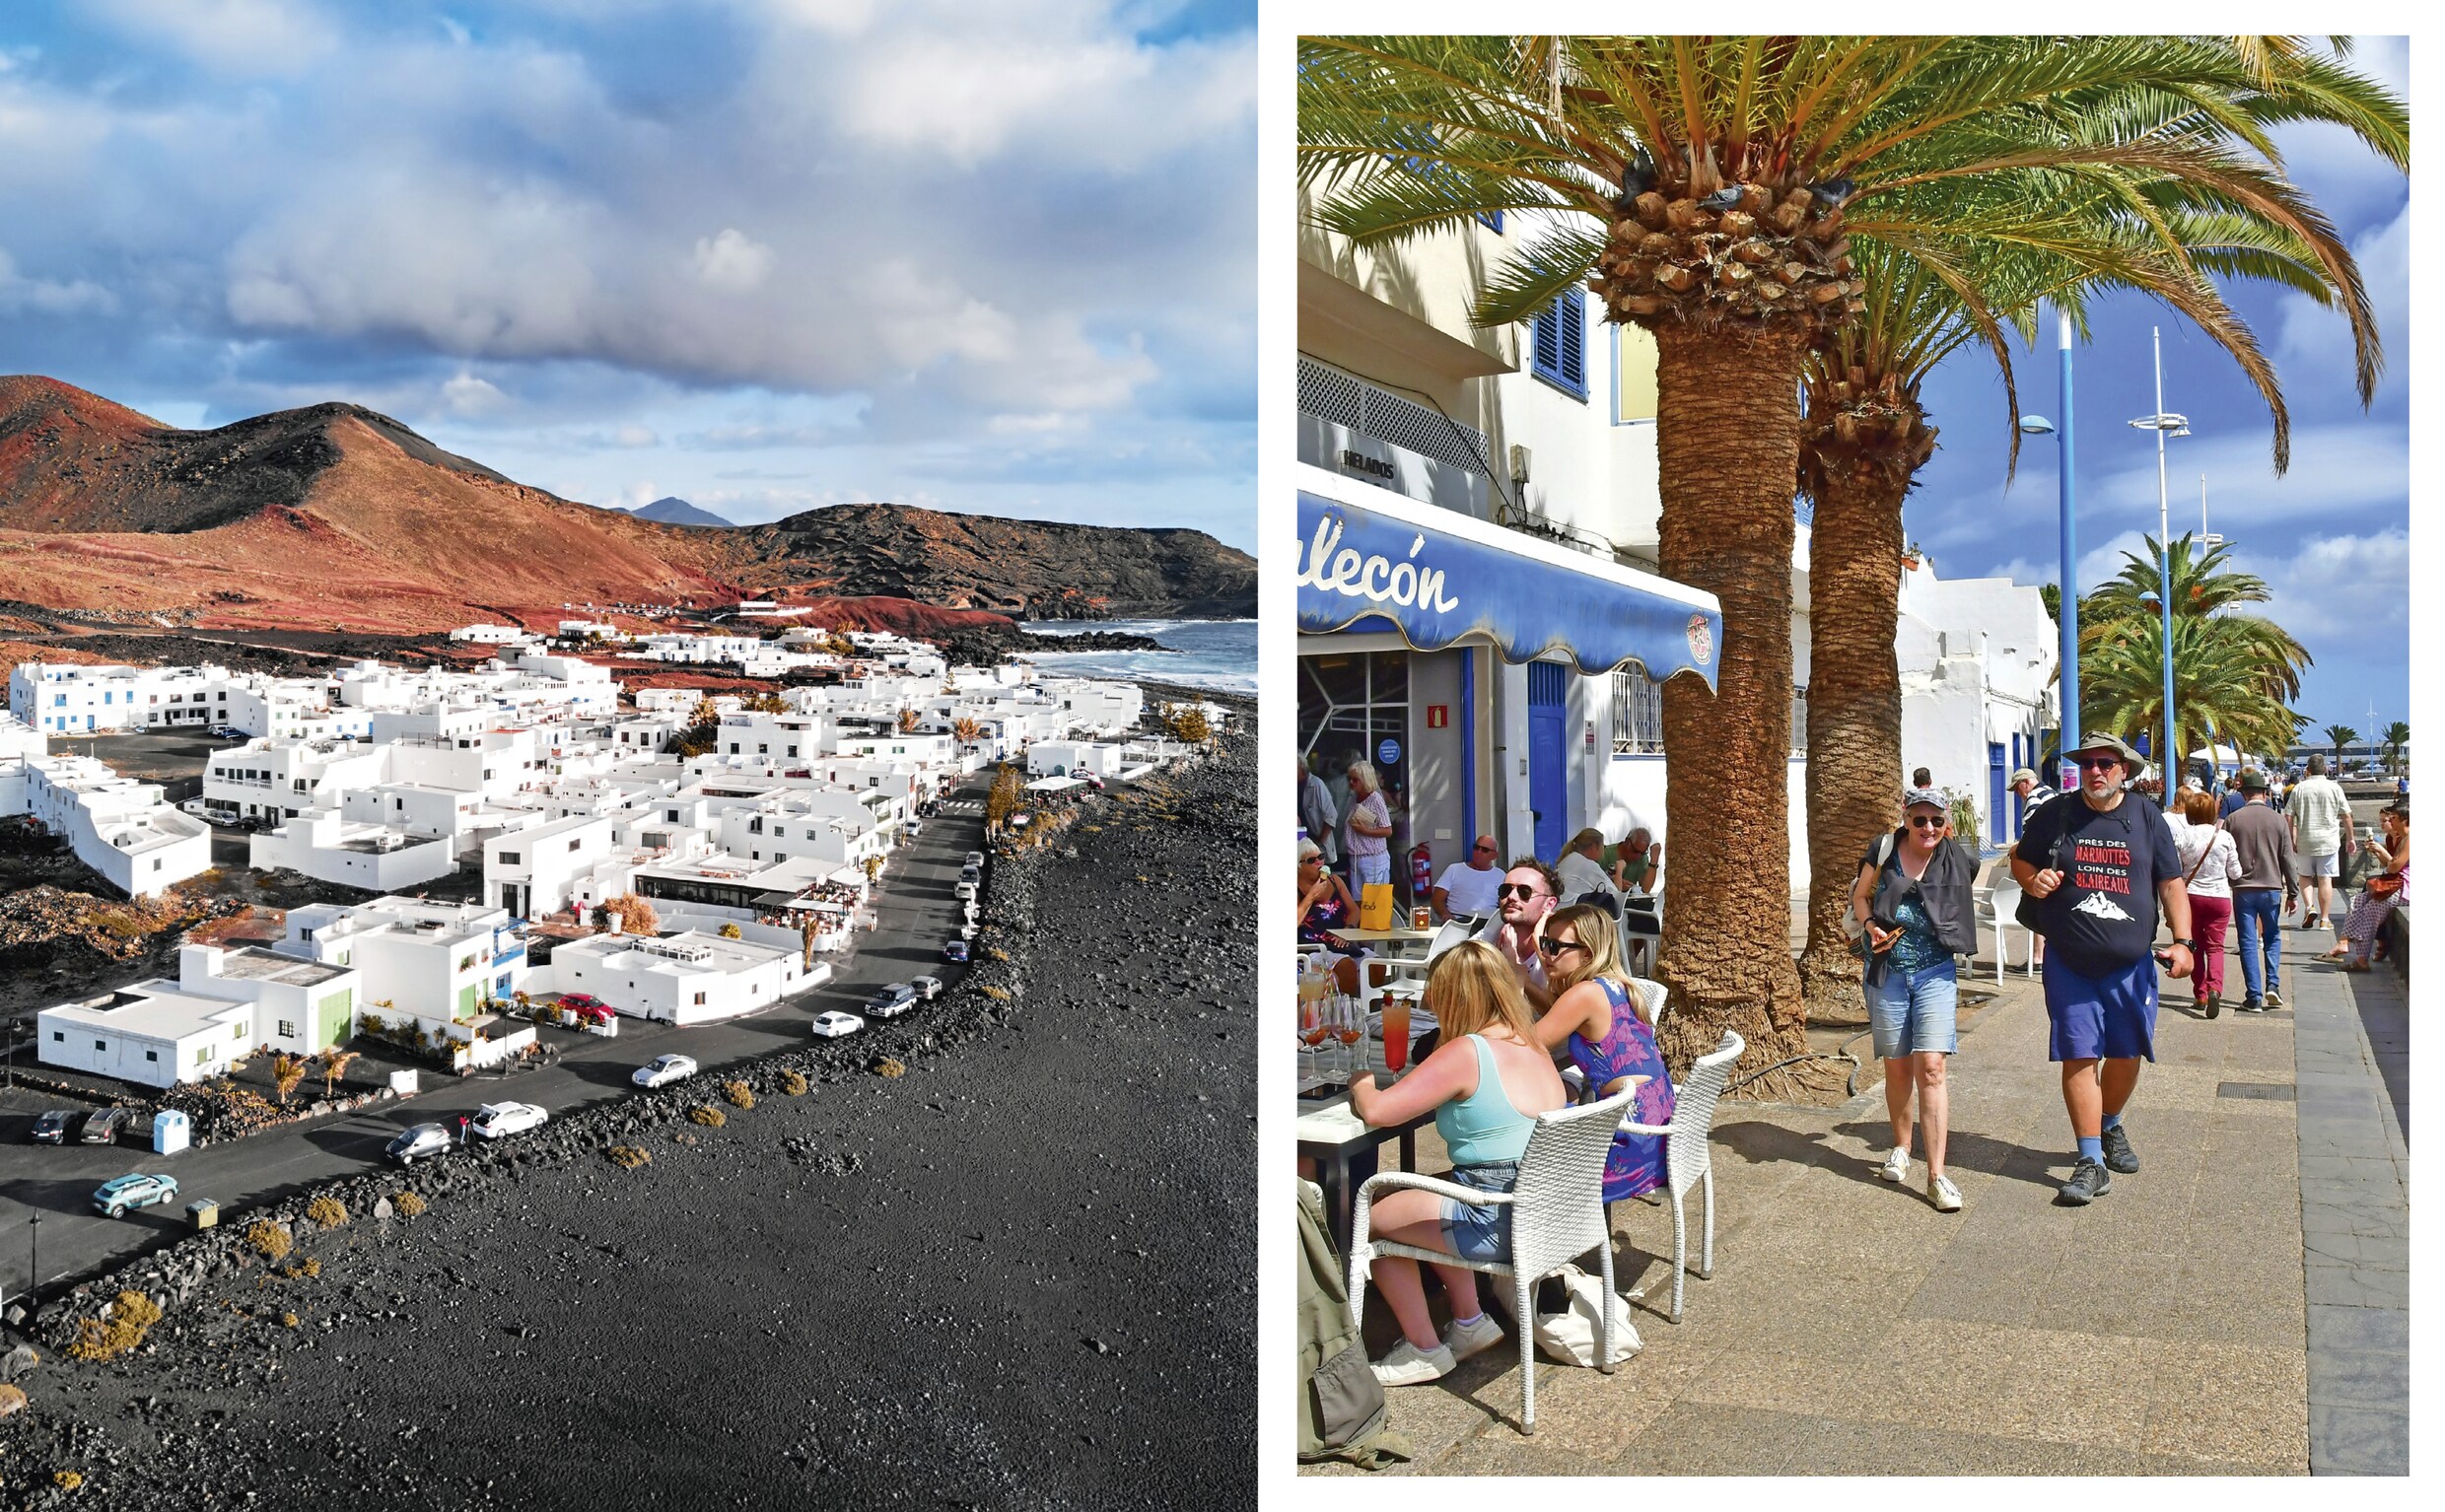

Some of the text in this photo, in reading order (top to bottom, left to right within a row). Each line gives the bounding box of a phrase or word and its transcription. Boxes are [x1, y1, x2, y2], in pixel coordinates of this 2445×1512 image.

[1343, 449, 1394, 480] HELADOS
[2078, 838, 2127, 849] PRÈS DES
[2074, 845, 2131, 866] MARMOTTES
[2077, 864, 2128, 876] LOIN DES
[2075, 872, 2131, 895] BLAIREAUX
